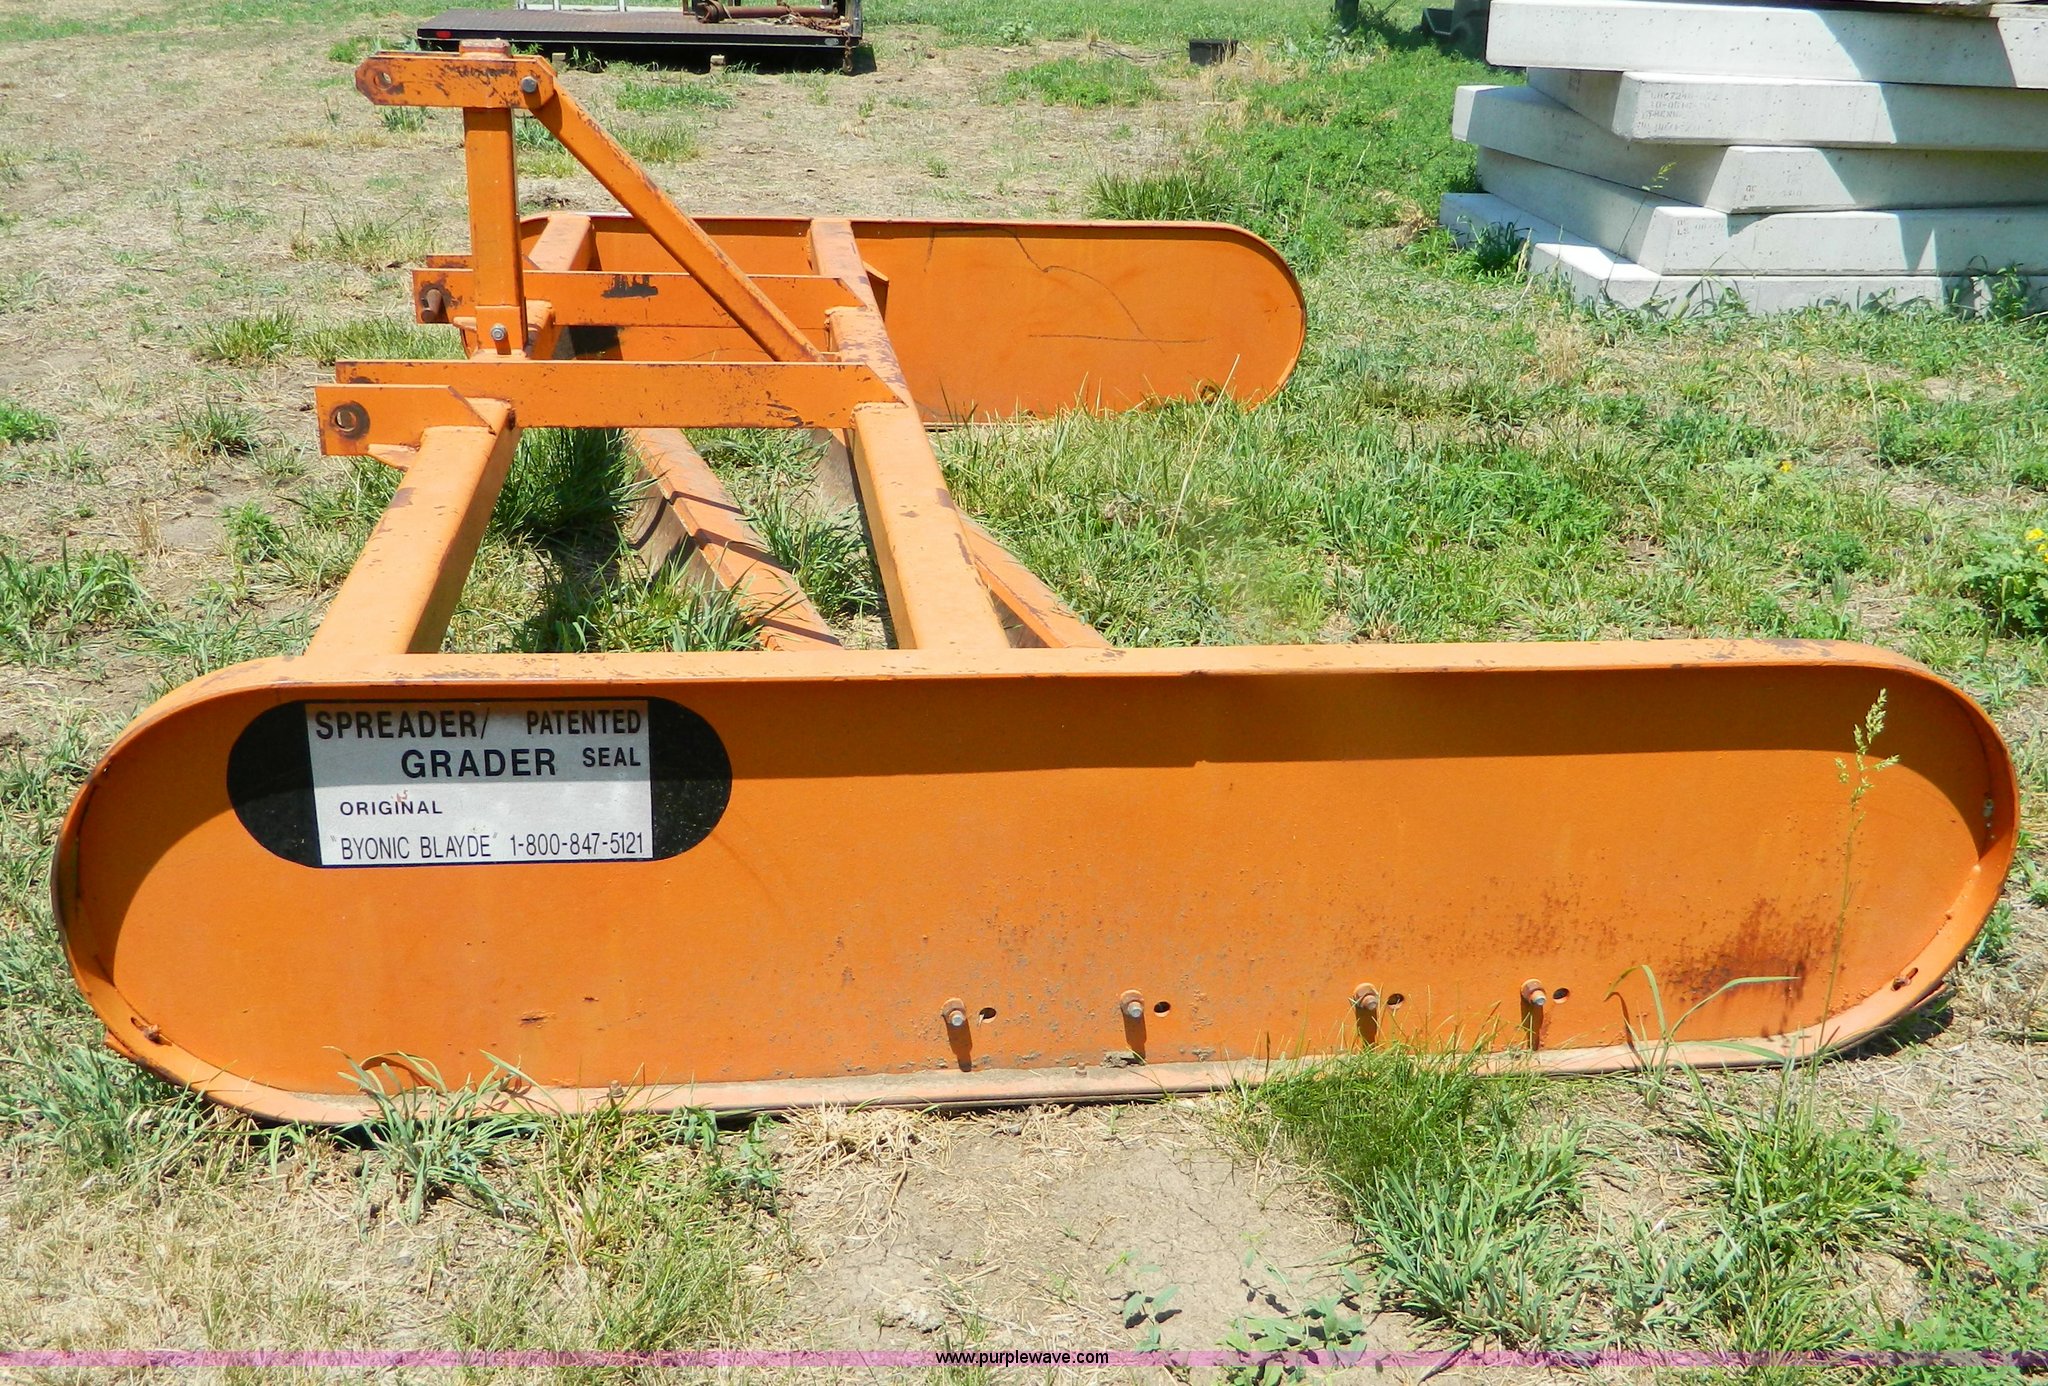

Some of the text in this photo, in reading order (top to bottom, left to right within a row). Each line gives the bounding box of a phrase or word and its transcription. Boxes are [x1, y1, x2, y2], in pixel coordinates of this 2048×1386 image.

[315, 707, 490, 740] SPREADER/
[526, 709, 642, 735] PATENTED
[401, 748, 556, 779] GRADER
[582, 747, 641, 767] SEAL
[339, 800, 443, 816] ORIGINAL
[510, 831, 644, 857] 1-800-847-5121
